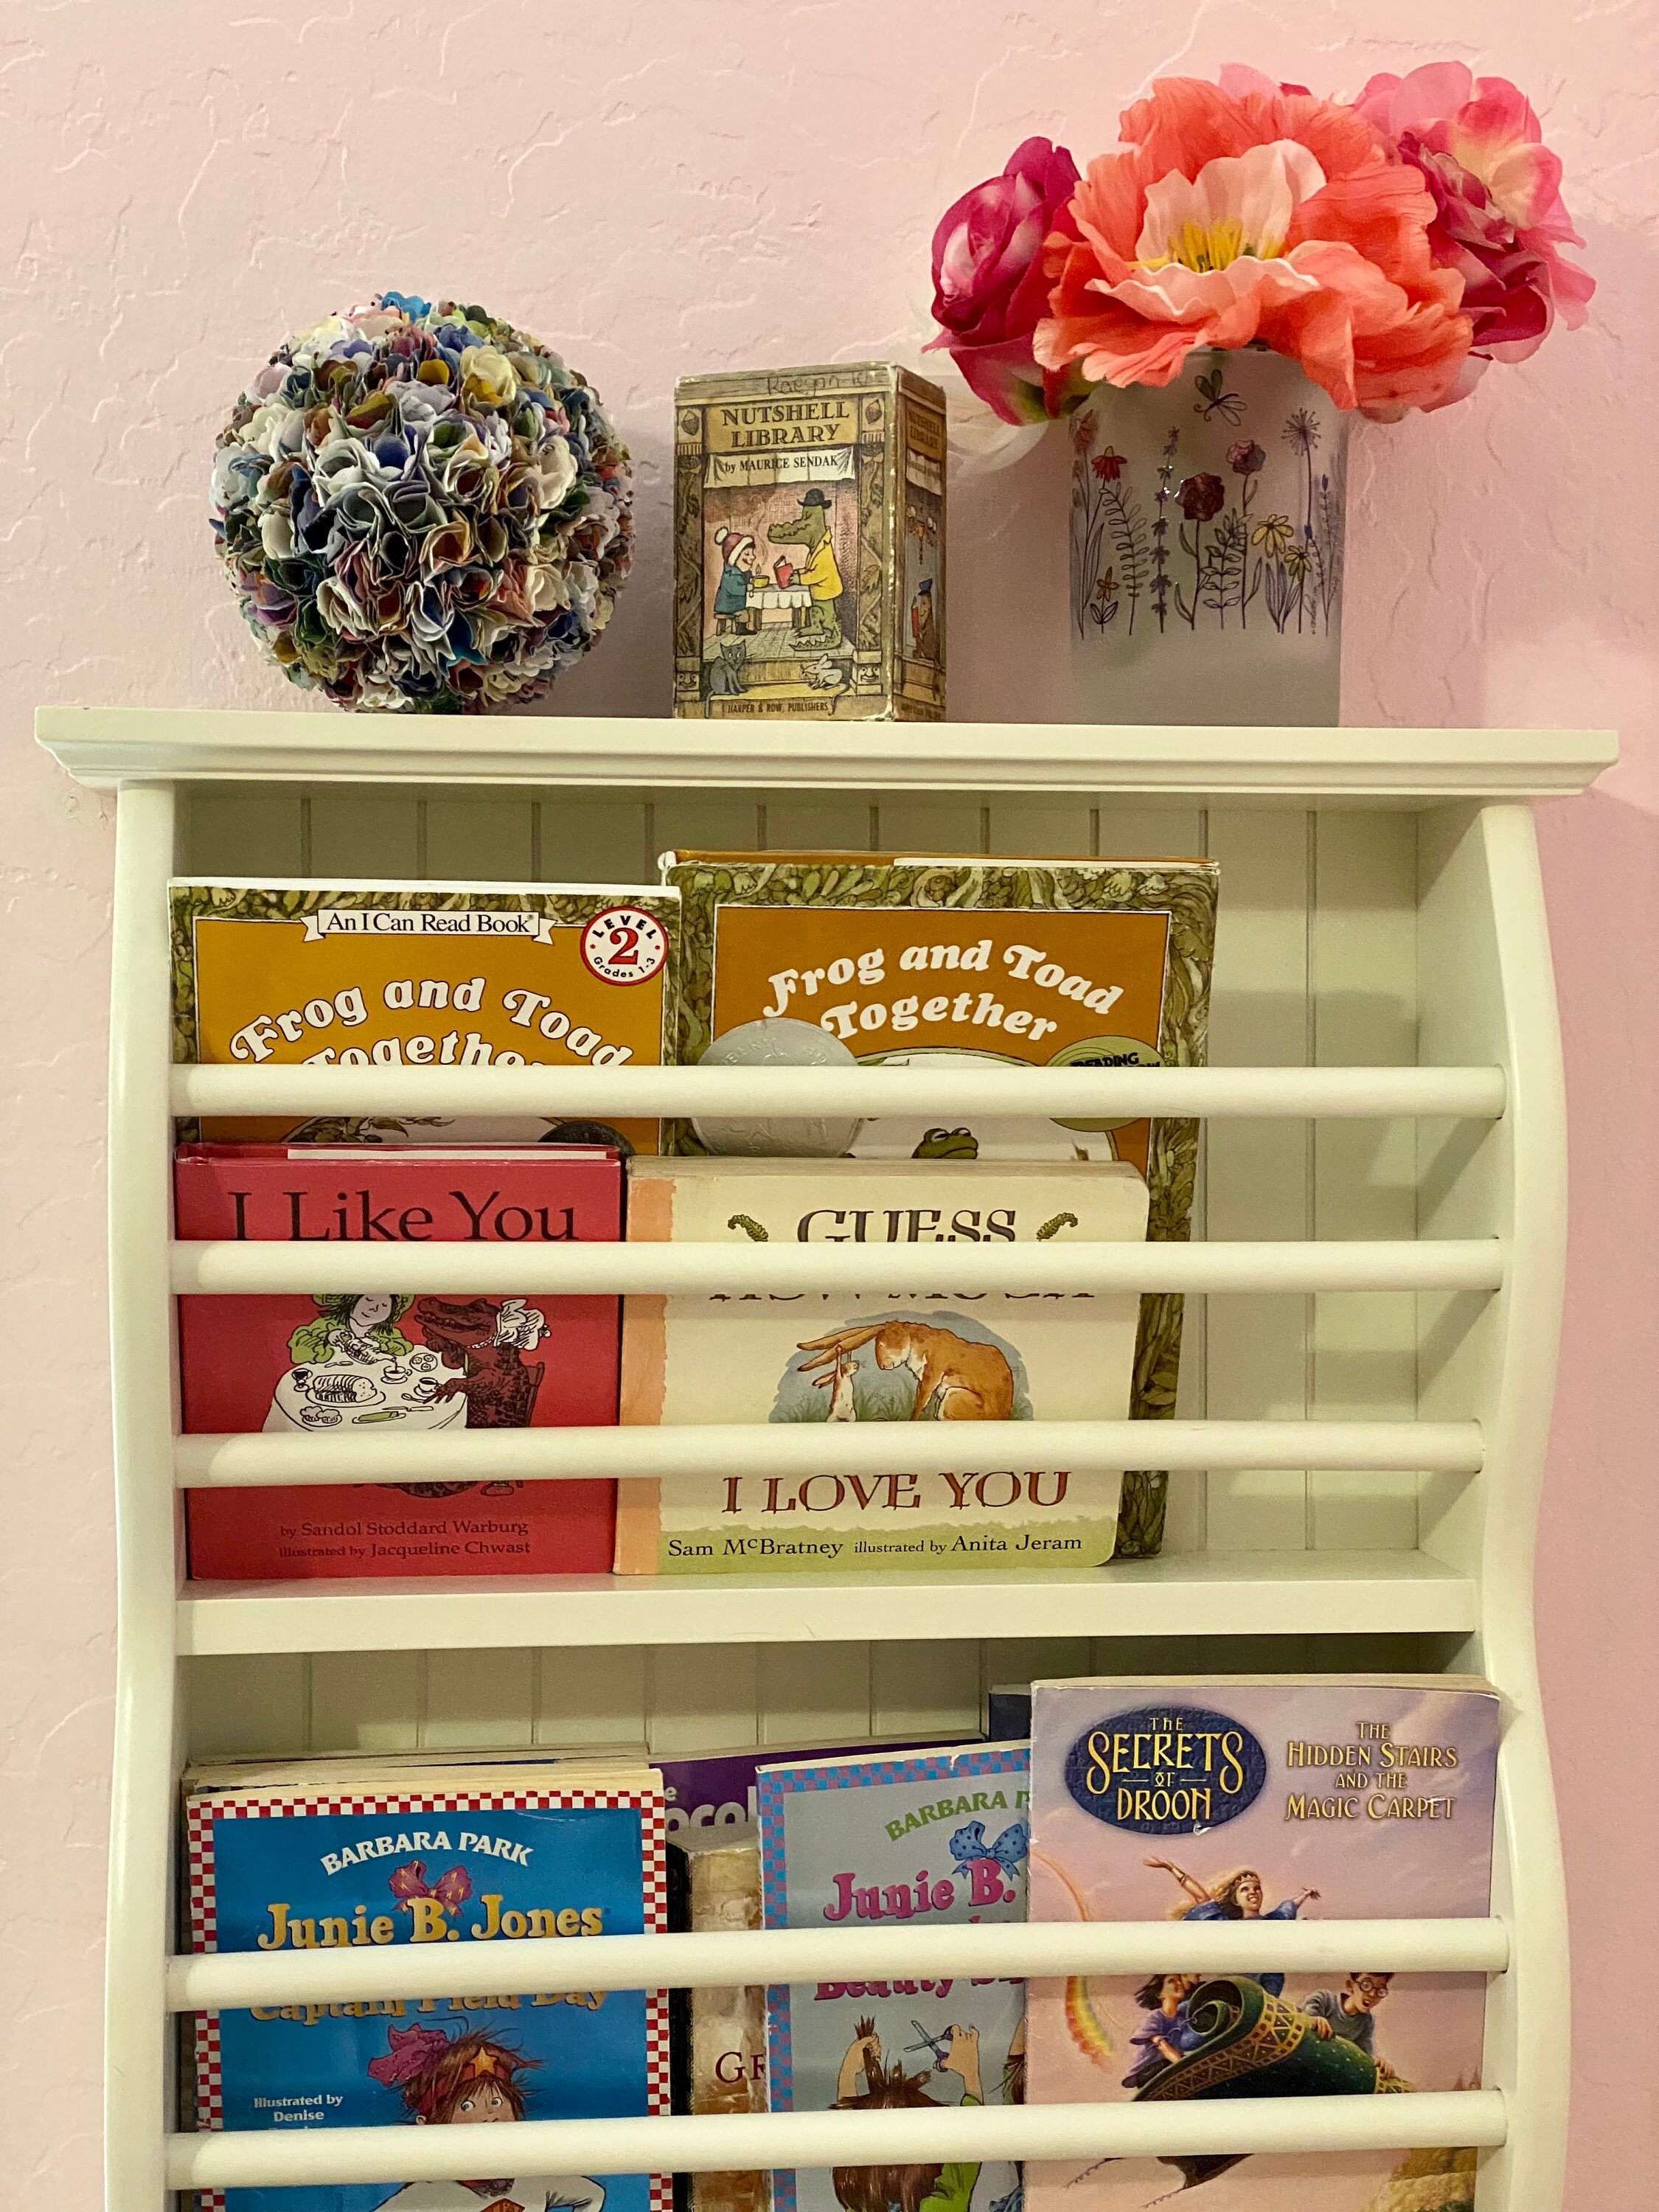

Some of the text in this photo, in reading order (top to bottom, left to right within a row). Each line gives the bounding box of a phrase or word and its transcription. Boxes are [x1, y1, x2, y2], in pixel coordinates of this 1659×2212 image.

[720, 401, 849, 426] NUTSHELL
[731, 423, 841, 448] LIBRARY
[725, 455, 839, 473] by MAURICE SENDAK
[728, 704, 755, 713] HARPER
[758, 703, 763, 713] &
[787, 702, 829, 712] PUBLISHERS
[327, 913, 356, 931] An
[363, 914, 369, 931] I
[373, 913, 414, 931] Can
[421, 914, 470, 932] Read
[592, 915, 657, 939] LEVEL
[608, 927, 639, 964] 2
[594, 956, 655, 978] Grades 1-3
[762, 939, 1124, 1019] Frog and Toad
[230, 986, 369, 1063] Frog
[383, 977, 486, 1012] and
[502, 989, 634, 1065] Toad
[820, 992, 1057, 1040] Together
[302, 1030, 546, 1065] ogethe
[228, 1190, 580, 1242] I Like You
[797, 1209, 1015, 1242] GUESS
[722, 1471, 1072, 1514] I LOVE YOU
[281, 1520, 529, 1538] by Sandol Stoddard Warburg
[279, 1541, 530, 1559] illustrated by Jacqueline Chwast
[668, 1539, 844, 1559] Sam McBratney
[854, 1534, 1082, 1555] illustrated by Anita Jeram
[1357, 1721, 1391, 1739] THE
[1086, 1731, 1244, 1795] SECRETS
[1287, 1740, 1458, 1768] HIDDEN STAIRS
[1335, 1773, 1408, 1789] AND THE
[884, 1790, 1009, 1841] BARBARA
[1117, 1787, 1211, 1820] DROON
[1284, 1793, 1359, 1820] MAGIC
[320, 1831, 534, 1876] BARBARA PARK
[824, 1857, 1017, 1921] Junie B.
[257, 1894, 602, 1950] Junie B. Jones
[254, 2094, 344, 2108] Illustrated by
[274, 2110, 324, 2122] Denise
